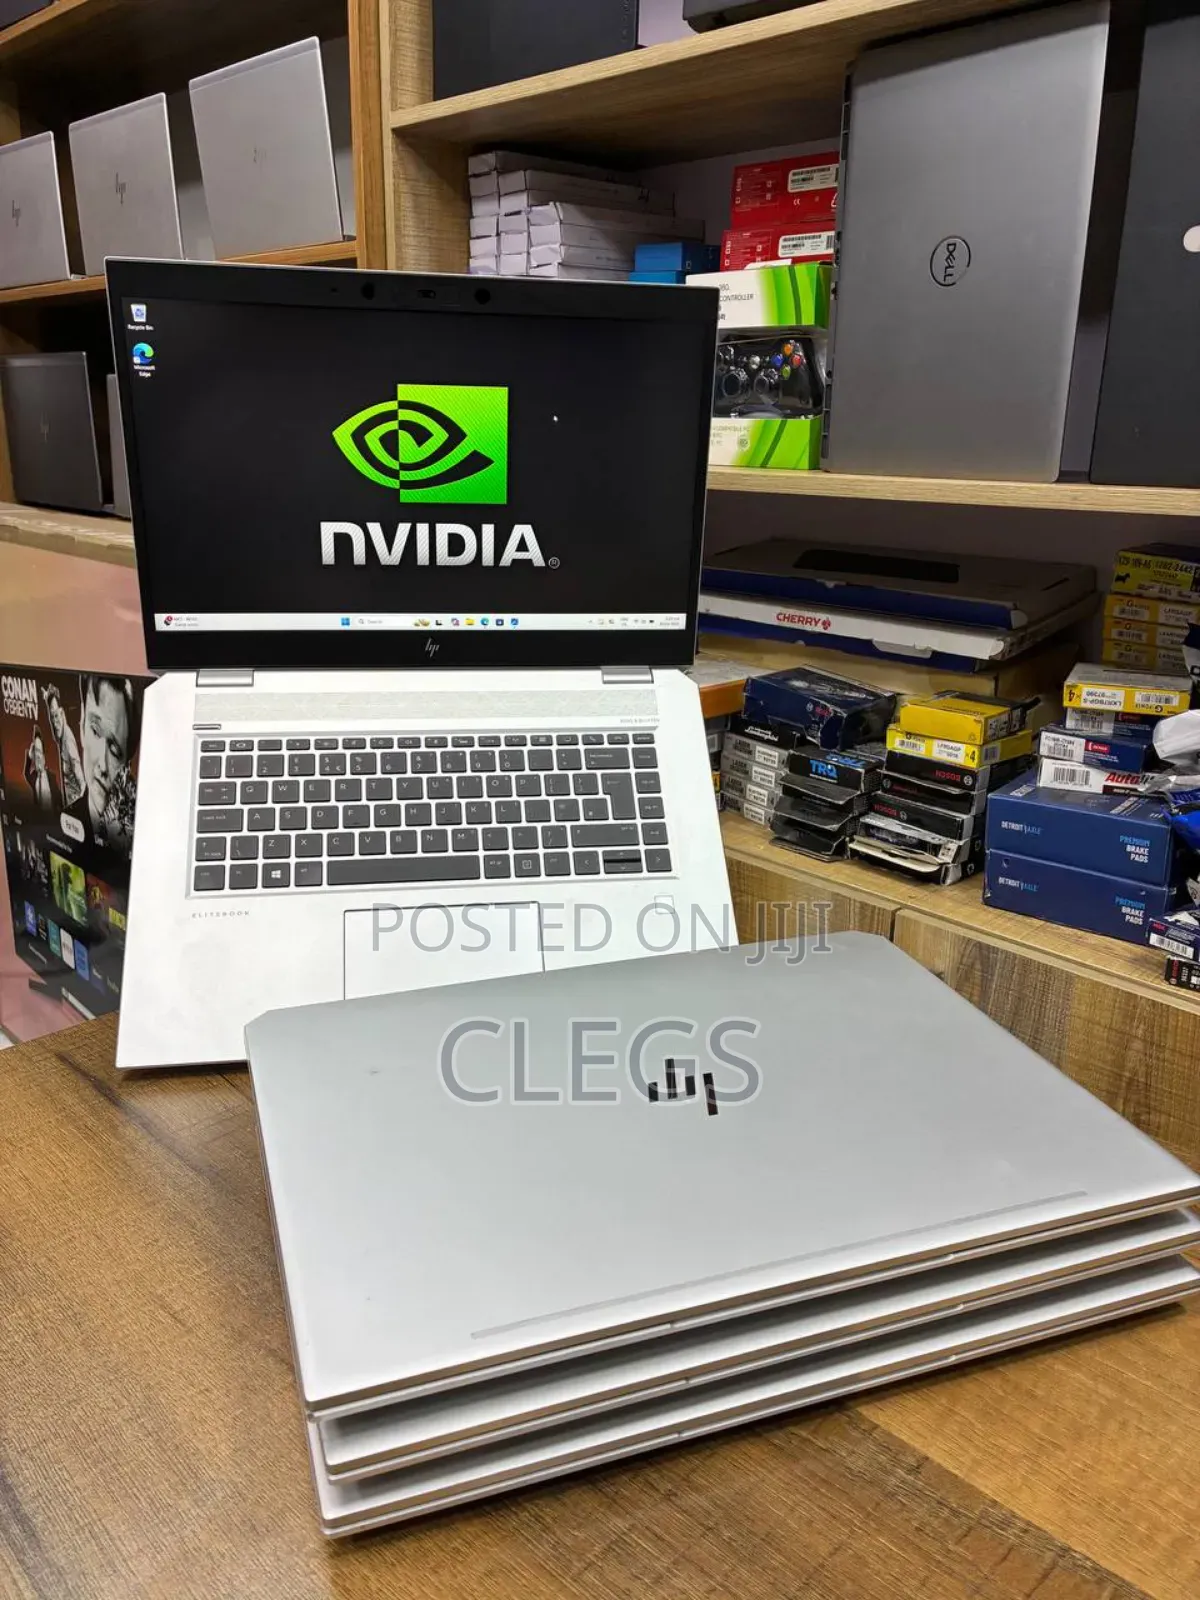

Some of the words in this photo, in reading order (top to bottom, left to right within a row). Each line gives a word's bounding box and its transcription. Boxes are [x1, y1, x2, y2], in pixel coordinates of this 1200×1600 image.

[943, 243, 957, 283] DELL
[776, 612, 821, 627] CHERRY
[1, 675, 38, 703] CONAN
[809, 760, 838, 779] TRQ
[1001, 820, 1023, 832] DETROIT
[1120, 835, 1150, 847] PREMIUM
[1126, 844, 1149, 856] BRAKE
[1130, 853, 1148, 863] PADS
[1121, 905, 1144, 918] BRAKE
[1125, 914, 1143, 925] PADS
